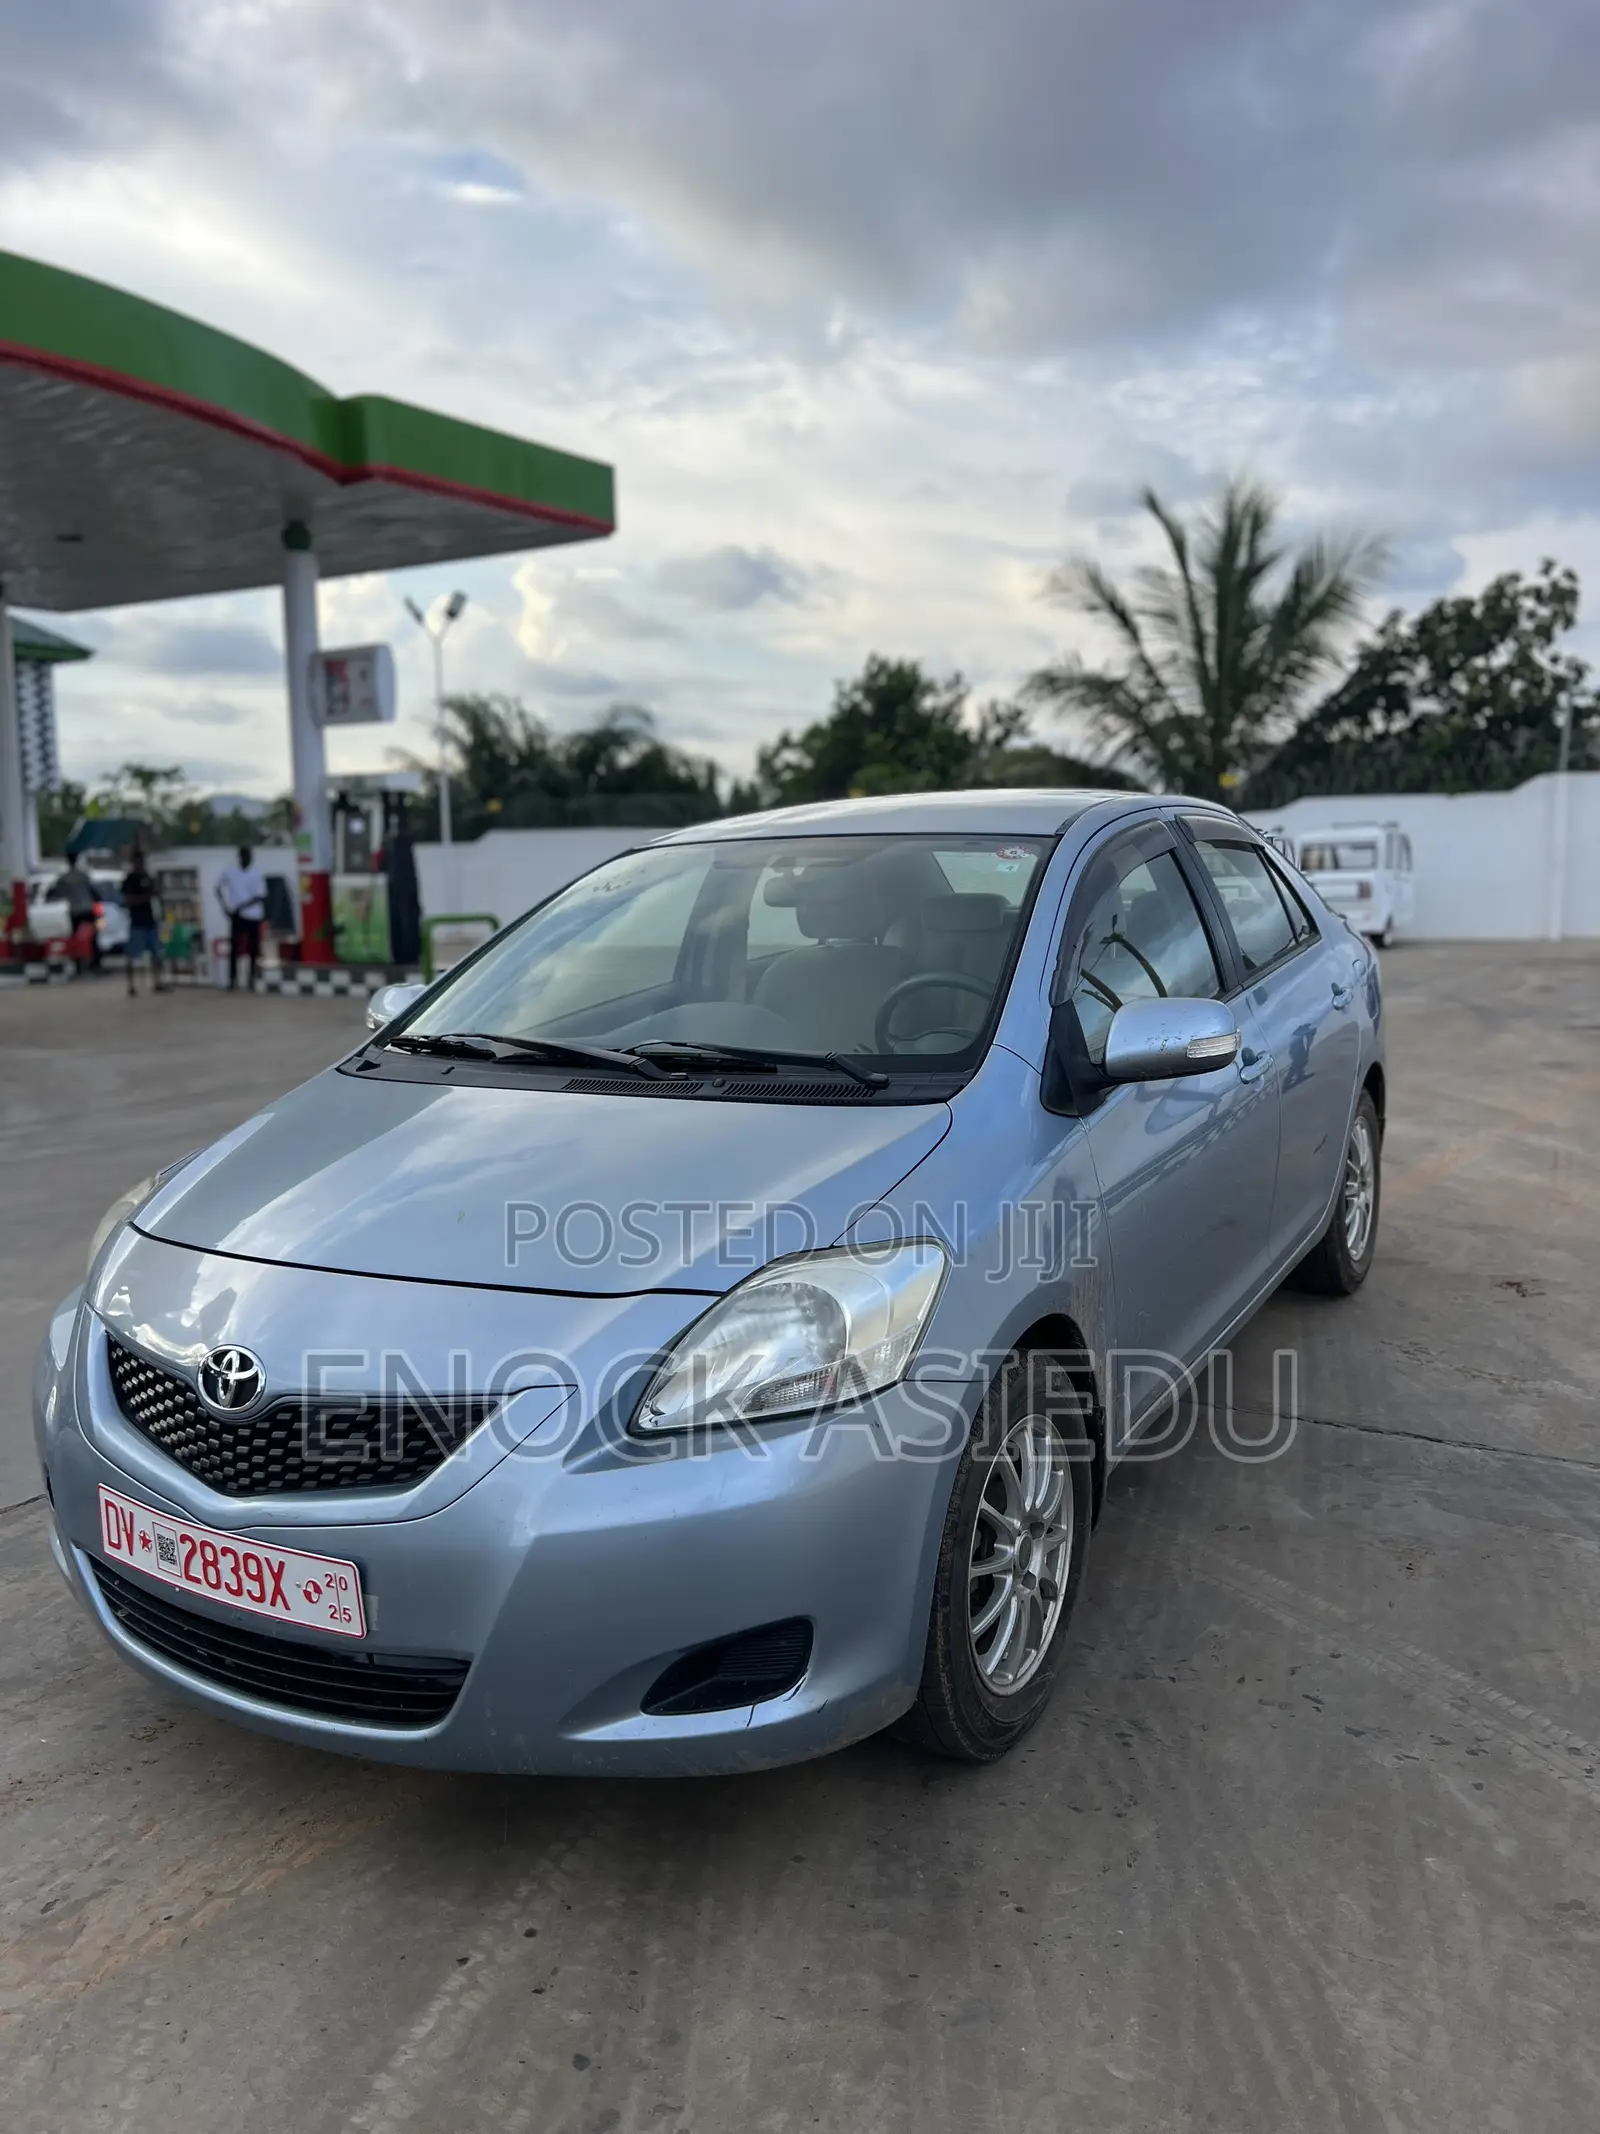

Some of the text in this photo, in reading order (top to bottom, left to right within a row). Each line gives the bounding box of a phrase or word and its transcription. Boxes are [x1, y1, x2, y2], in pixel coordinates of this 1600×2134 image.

[104, 1499, 291, 1611] DV 2839X
[324, 1573, 348, 1592] 20
[328, 1604, 352, 1623] 25
